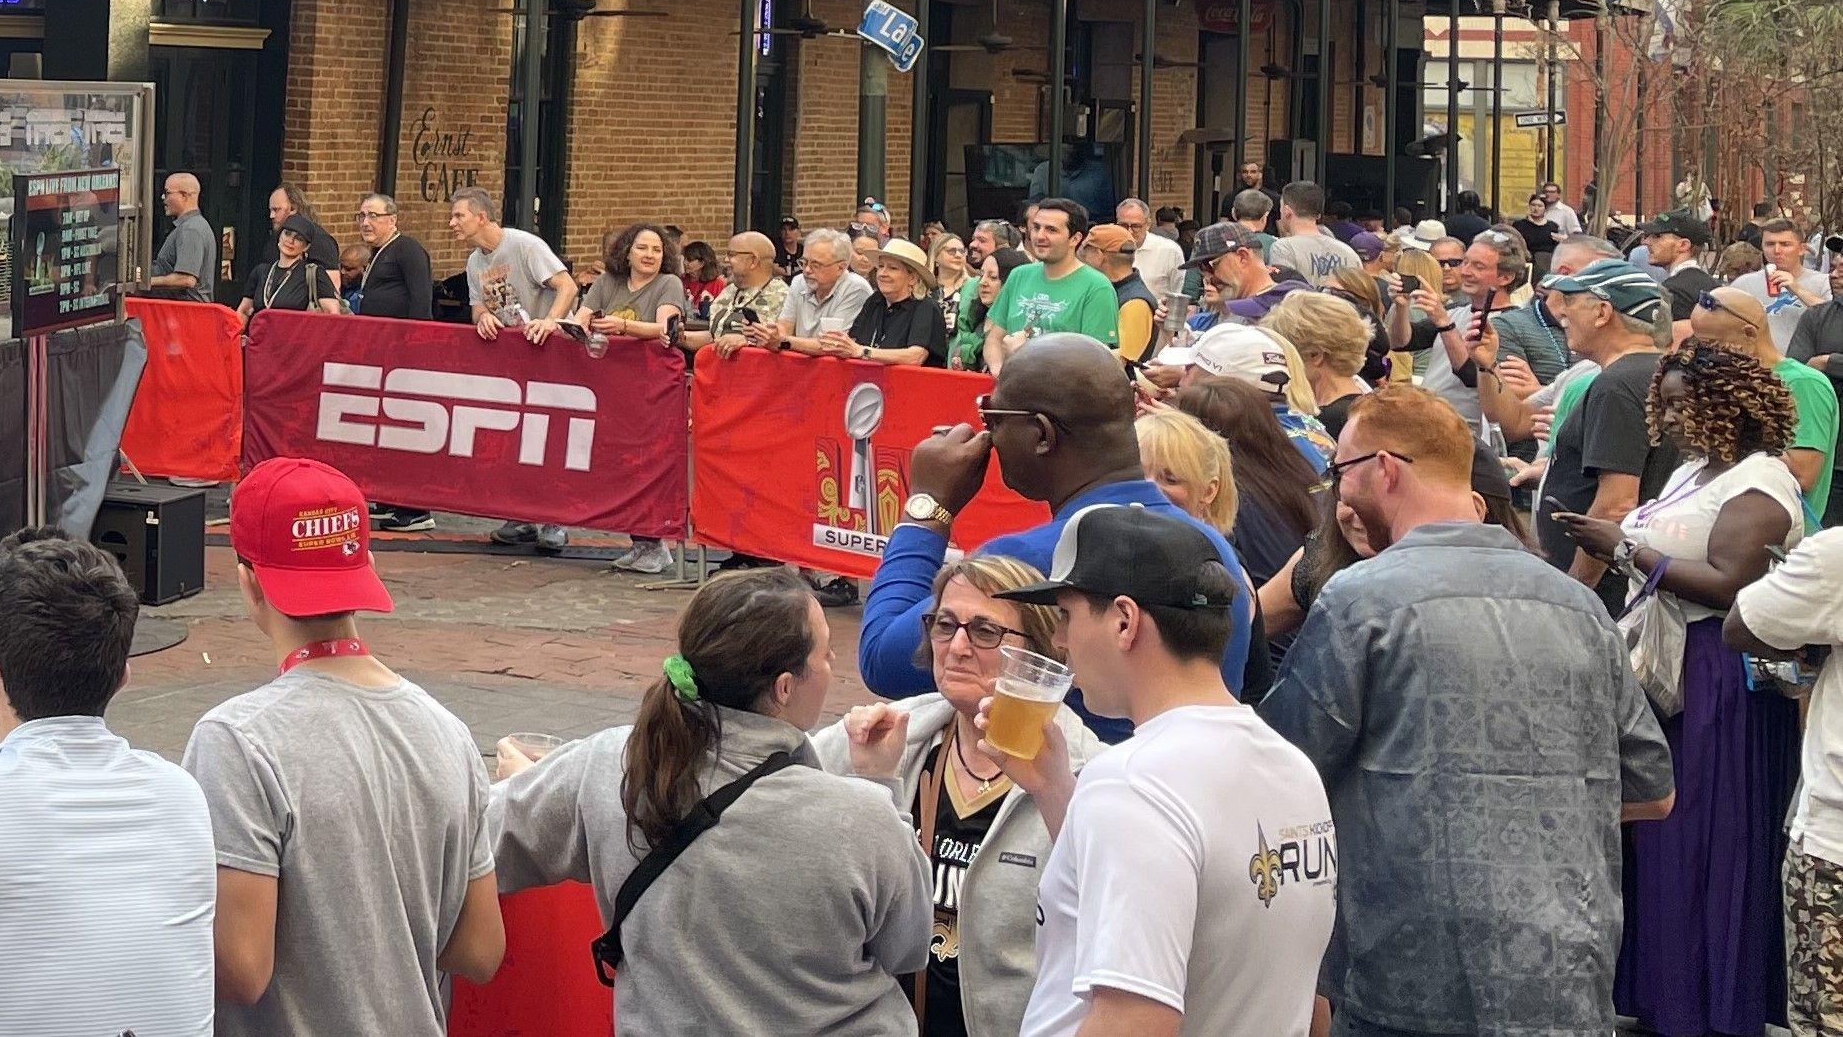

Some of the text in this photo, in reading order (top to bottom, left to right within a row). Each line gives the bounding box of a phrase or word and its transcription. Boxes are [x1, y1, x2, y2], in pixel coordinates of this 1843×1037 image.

[410, 106, 473, 165] Ernst
[316, 362, 597, 472] ESPN
[291, 509, 360, 538] CHIEFS
[825, 529, 887, 553] SUPER
